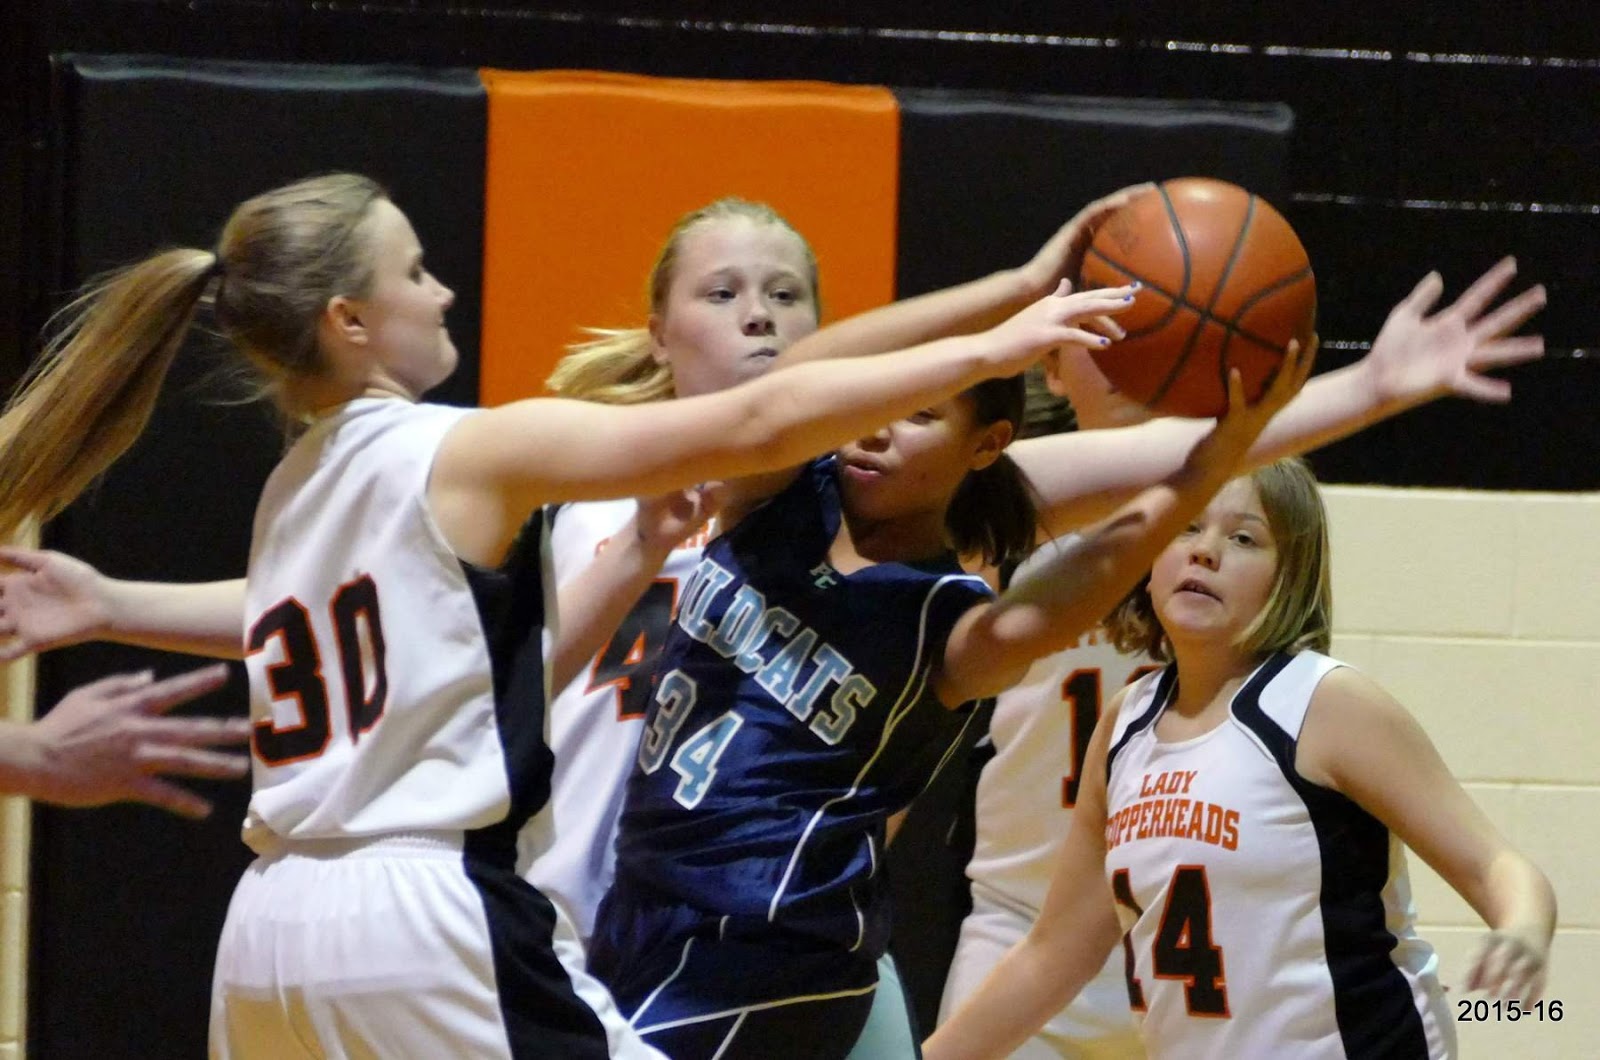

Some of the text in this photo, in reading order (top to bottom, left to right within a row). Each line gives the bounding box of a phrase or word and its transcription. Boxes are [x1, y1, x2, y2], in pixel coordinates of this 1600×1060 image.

[243, 572, 388, 768] 30
[585, 577, 678, 722] 4
[678, 557, 877, 746] ILDCATS
[638, 668, 745, 811] 34
[1139, 770, 1198, 798] LADY
[1112, 864, 1232, 1019] 14
